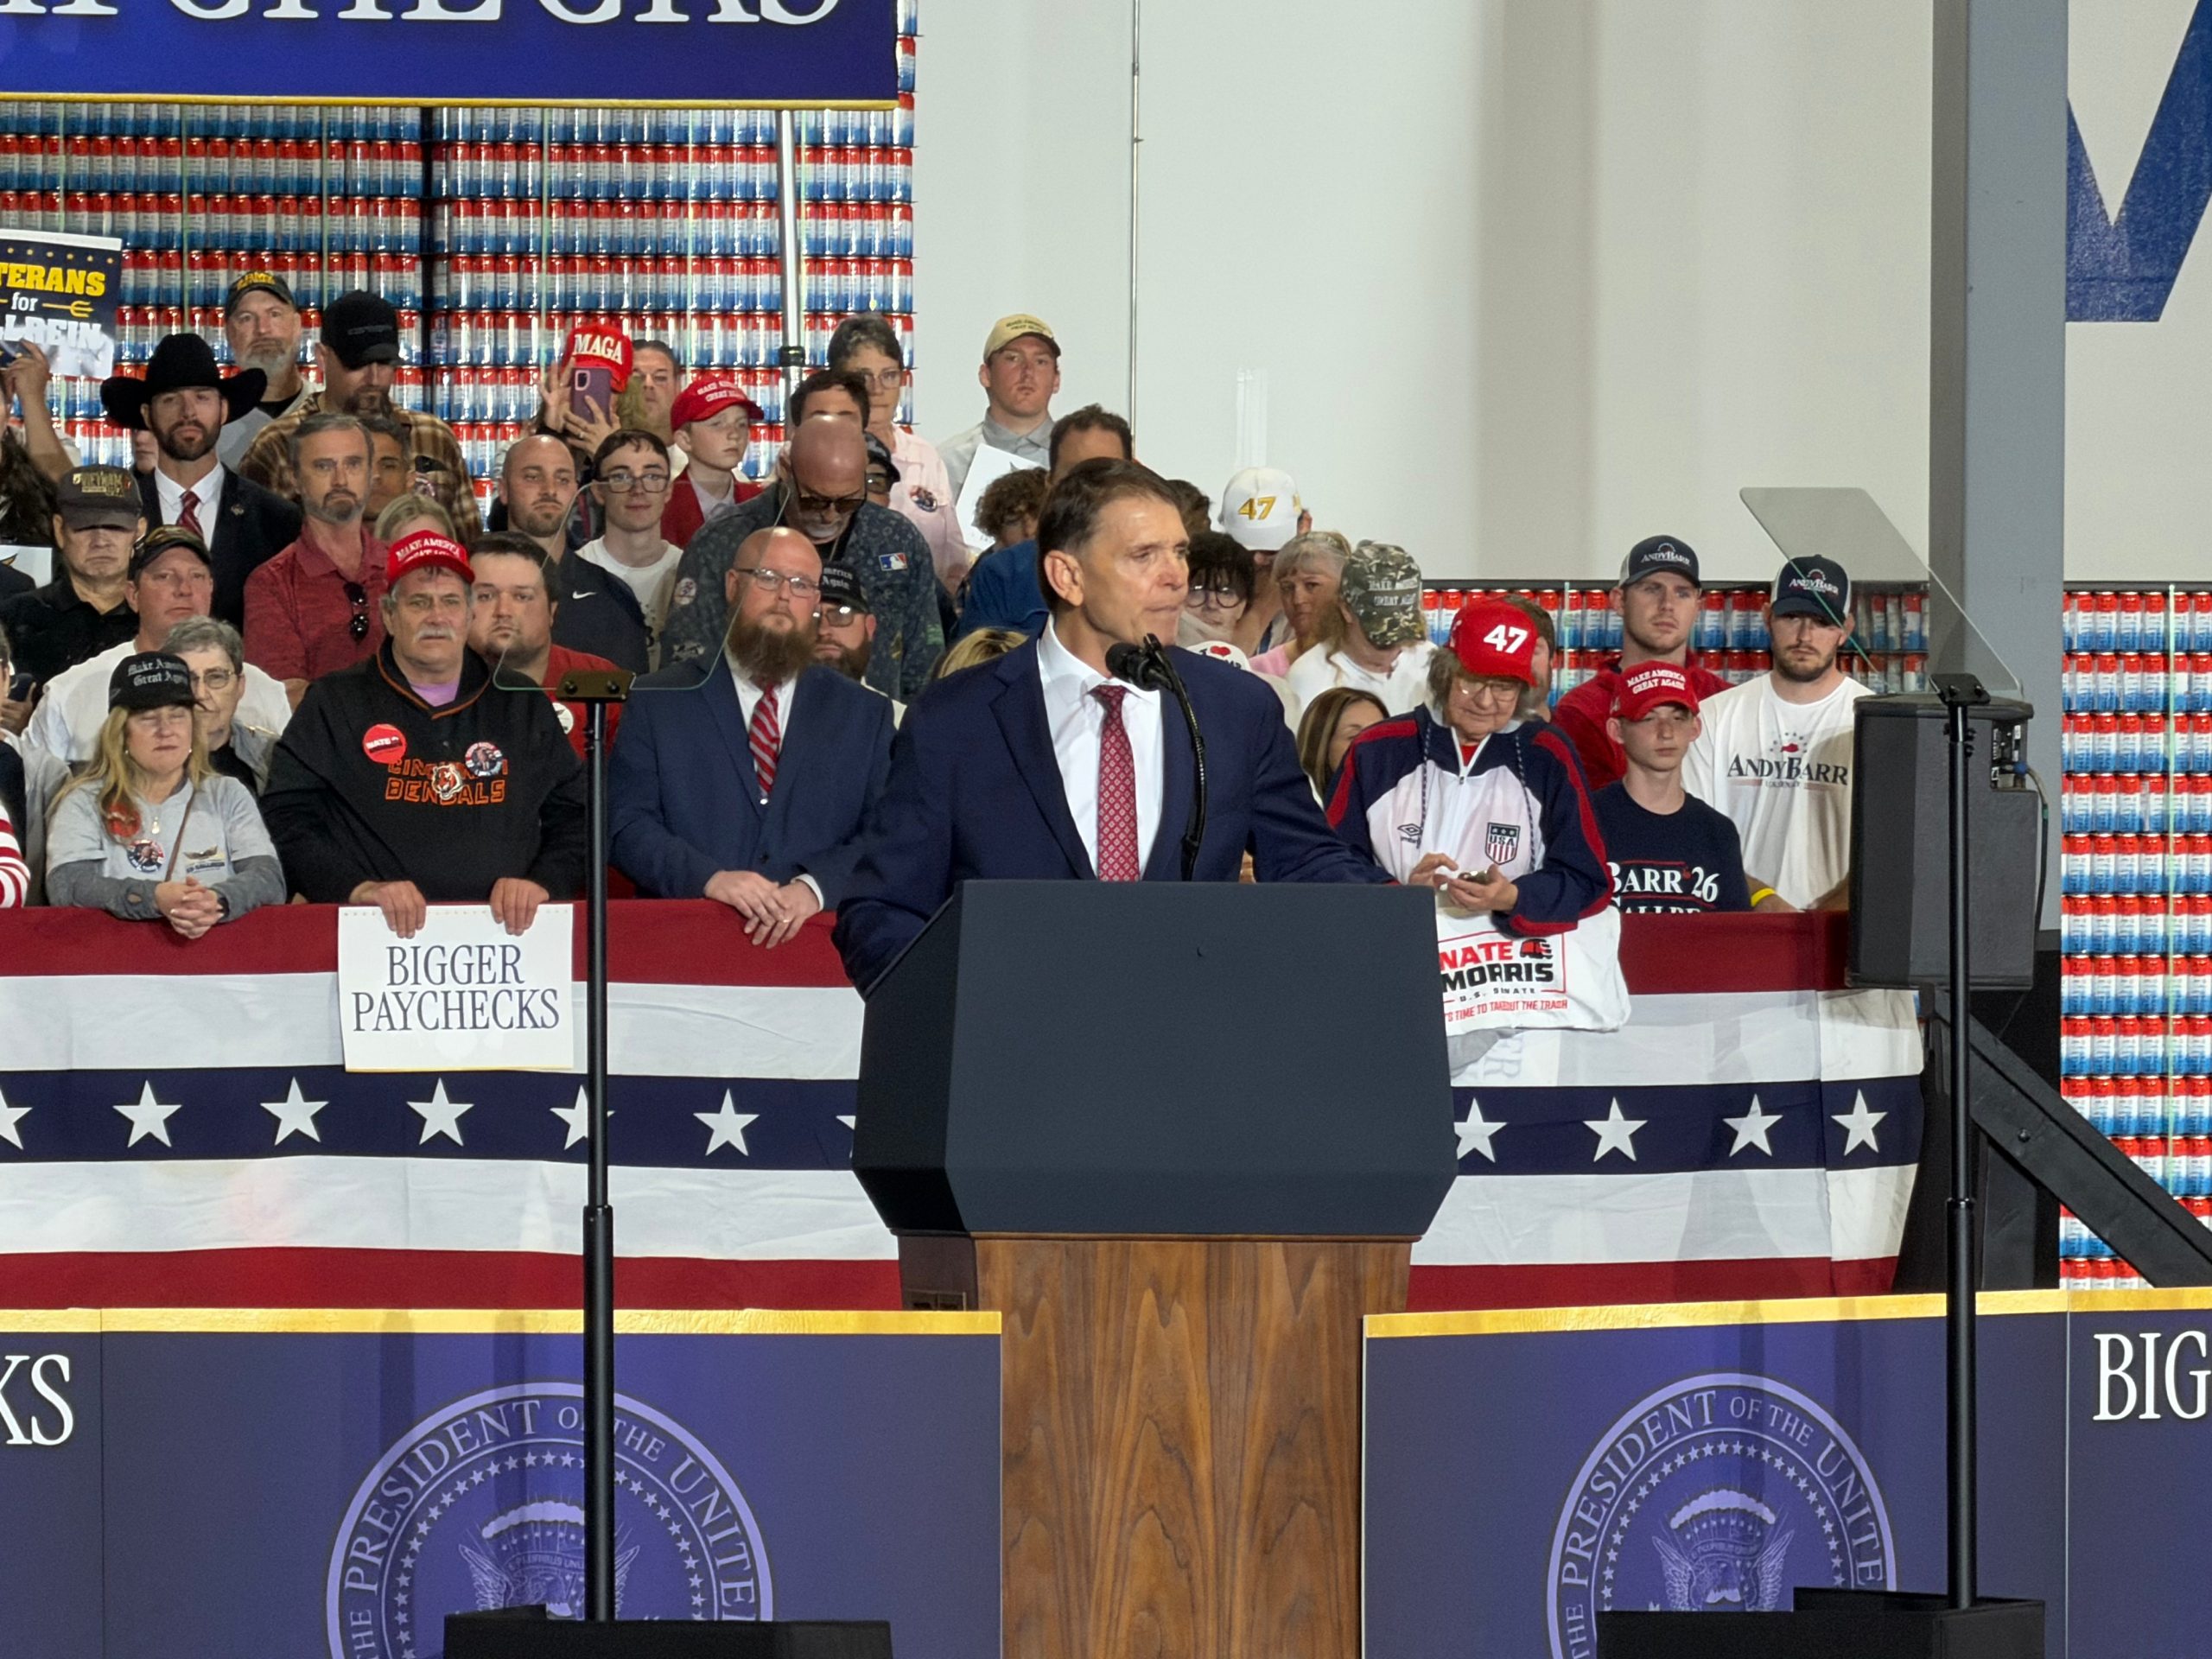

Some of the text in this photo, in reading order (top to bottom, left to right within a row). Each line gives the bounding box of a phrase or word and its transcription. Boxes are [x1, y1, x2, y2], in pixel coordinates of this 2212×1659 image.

[11, 291, 39, 311] for
[572, 334, 623, 365] MAGA
[1237, 496, 1276, 520] 47
[396, 539, 423, 562] MAKE
[1483, 625, 1529, 654] 47
[133, 672, 162, 687] Great
[1627, 670, 1686, 688] MAKE AMERICA
[1632, 678, 1659, 695] GREAT
[1489, 835, 1516, 847] USA
[385, 944, 525, 986] BIGGER
[1440, 941, 1514, 971] NATE
[1440, 963, 1554, 993] MORRIS
[351, 988, 560, 1032] PAYCHECKS
[1455, 1006, 1476, 1021] TIME
[1477, 1003, 1487, 1014] TO
[1522, 1000, 1539, 1010] THE
[2093, 1331, 2212, 1420] BIG
[1561, 1390, 1717, 1587] PRESIDENT
[1729, 1395, 1763, 1421] OF
[1769, 1404, 1814, 1447] THE
[1816, 1438, 1884, 1587] UNITE
[345, 1400, 541, 1596] PRESIDENT
[558, 1407, 584, 1431] O
[670, 1453, 756, 1622] UNITE
